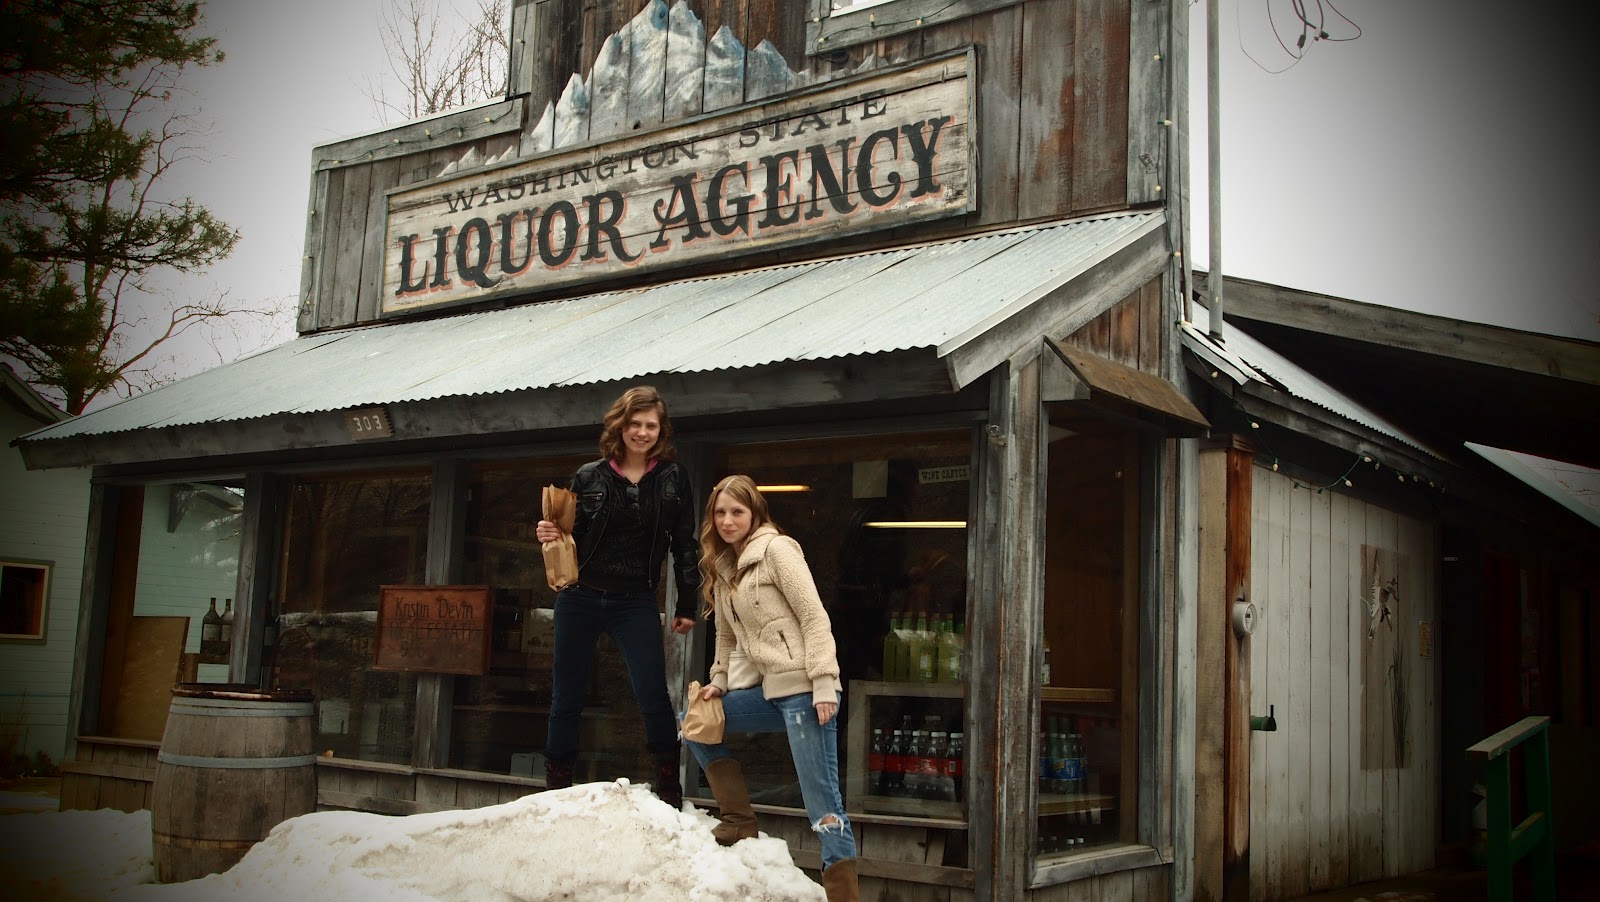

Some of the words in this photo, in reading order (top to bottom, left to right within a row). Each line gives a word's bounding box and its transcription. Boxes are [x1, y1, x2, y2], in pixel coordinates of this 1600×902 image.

[442, 137, 700, 213] WASHINGTON
[738, 88, 888, 148] STATE
[395, 190, 646, 298] LIQUOR
[649, 115, 955, 250] AGENCY
[353, 415, 382, 431] 303
[395, 597, 430, 618] Kristin
